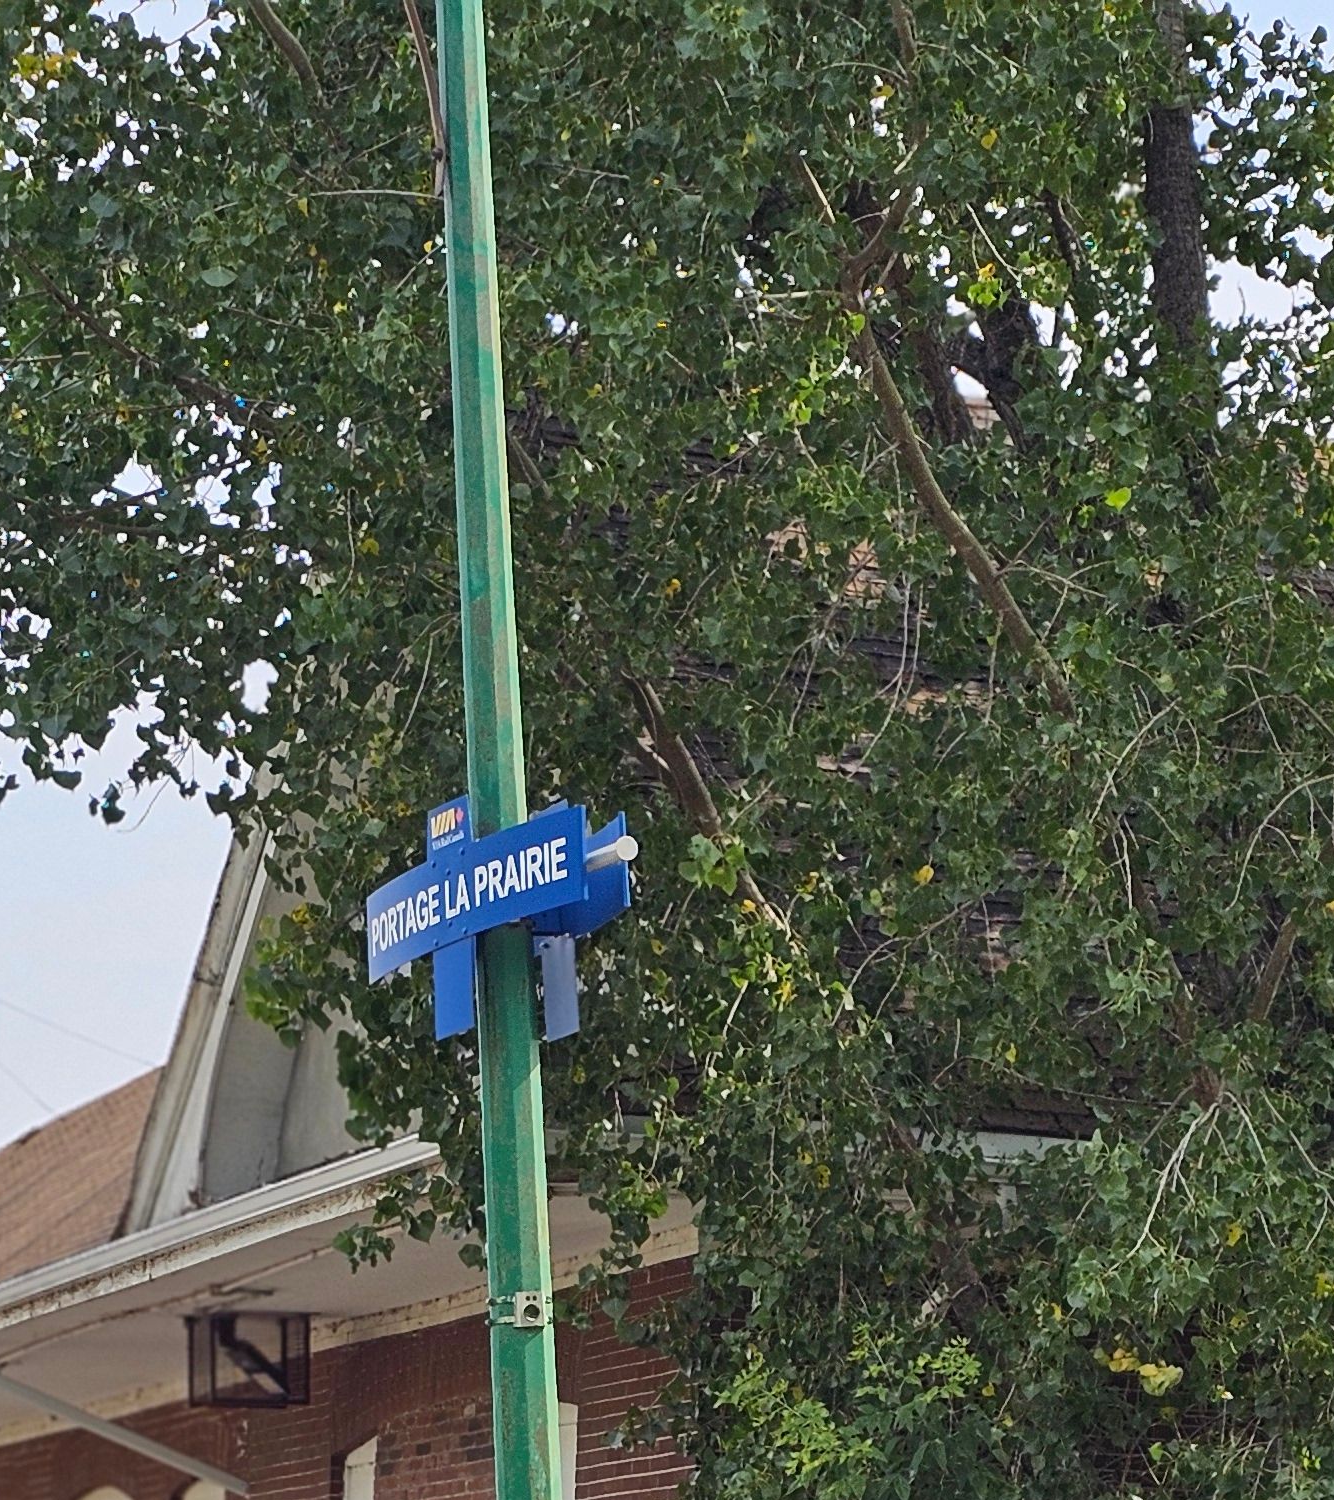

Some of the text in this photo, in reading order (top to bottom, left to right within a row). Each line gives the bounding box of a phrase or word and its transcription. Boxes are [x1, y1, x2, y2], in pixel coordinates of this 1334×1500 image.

[430, 807, 456, 839] VIA
[371, 837, 568, 957] PORTAGE LA PRAIRIE
